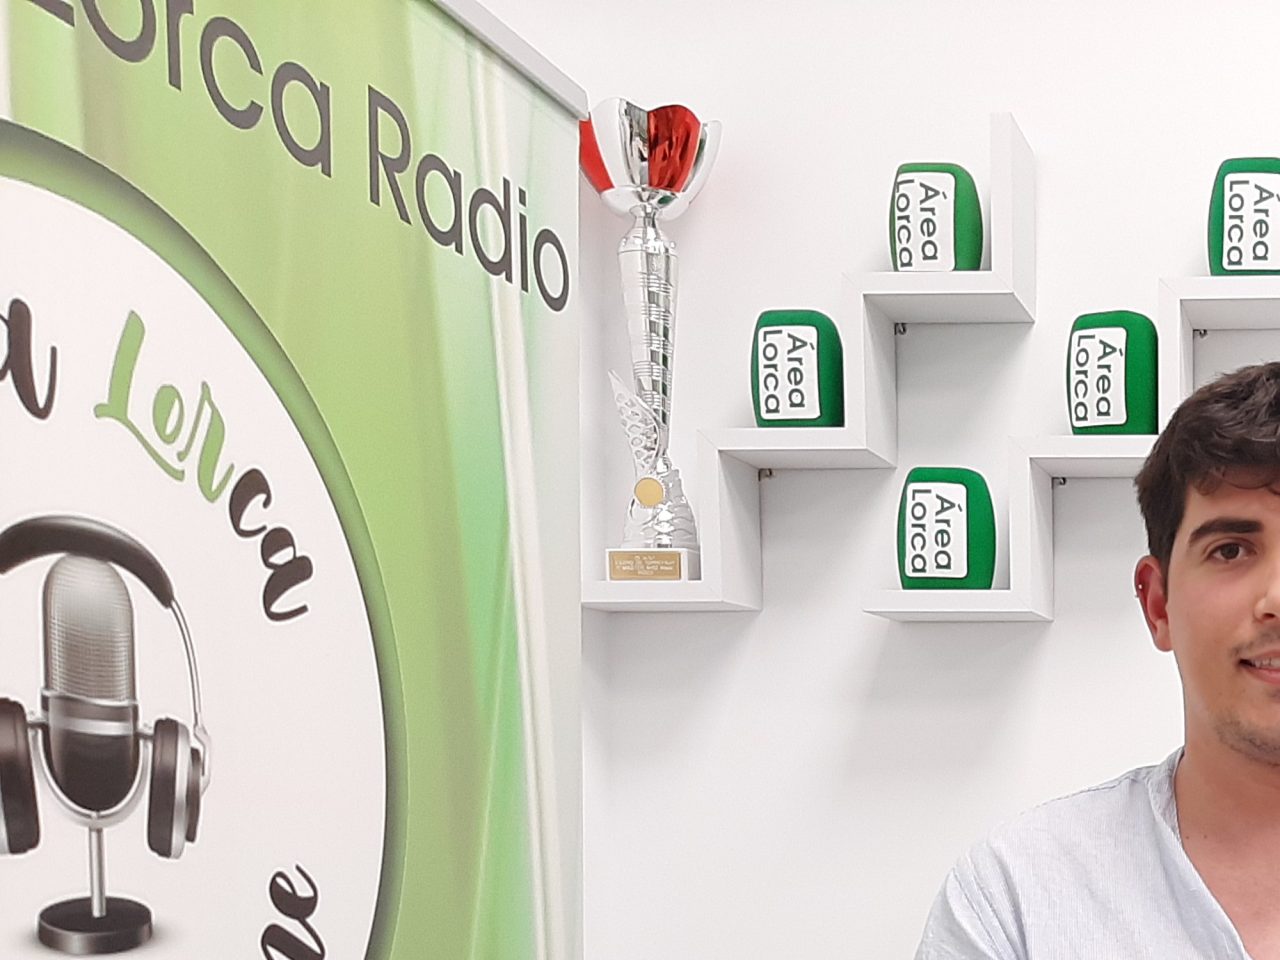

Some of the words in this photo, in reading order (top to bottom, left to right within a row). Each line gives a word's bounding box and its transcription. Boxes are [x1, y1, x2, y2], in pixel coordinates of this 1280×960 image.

[29, 0, 332, 178] orca
[367, 84, 570, 312] Radio
[896, 178, 915, 268] Lorca
[919, 181, 948, 261] Área
[1226, 179, 1250, 266] Lorca
[1252, 183, 1280, 261] Área
[762, 329, 783, 414] Lorca
[786, 332, 815, 408] Área
[1074, 333, 1096, 422] Lorca
[1095, 338, 1124, 417] Área
[93, 309, 314, 622] Lorca
[910, 488, 932, 573] Lorca
[934, 493, 963, 570] Área
